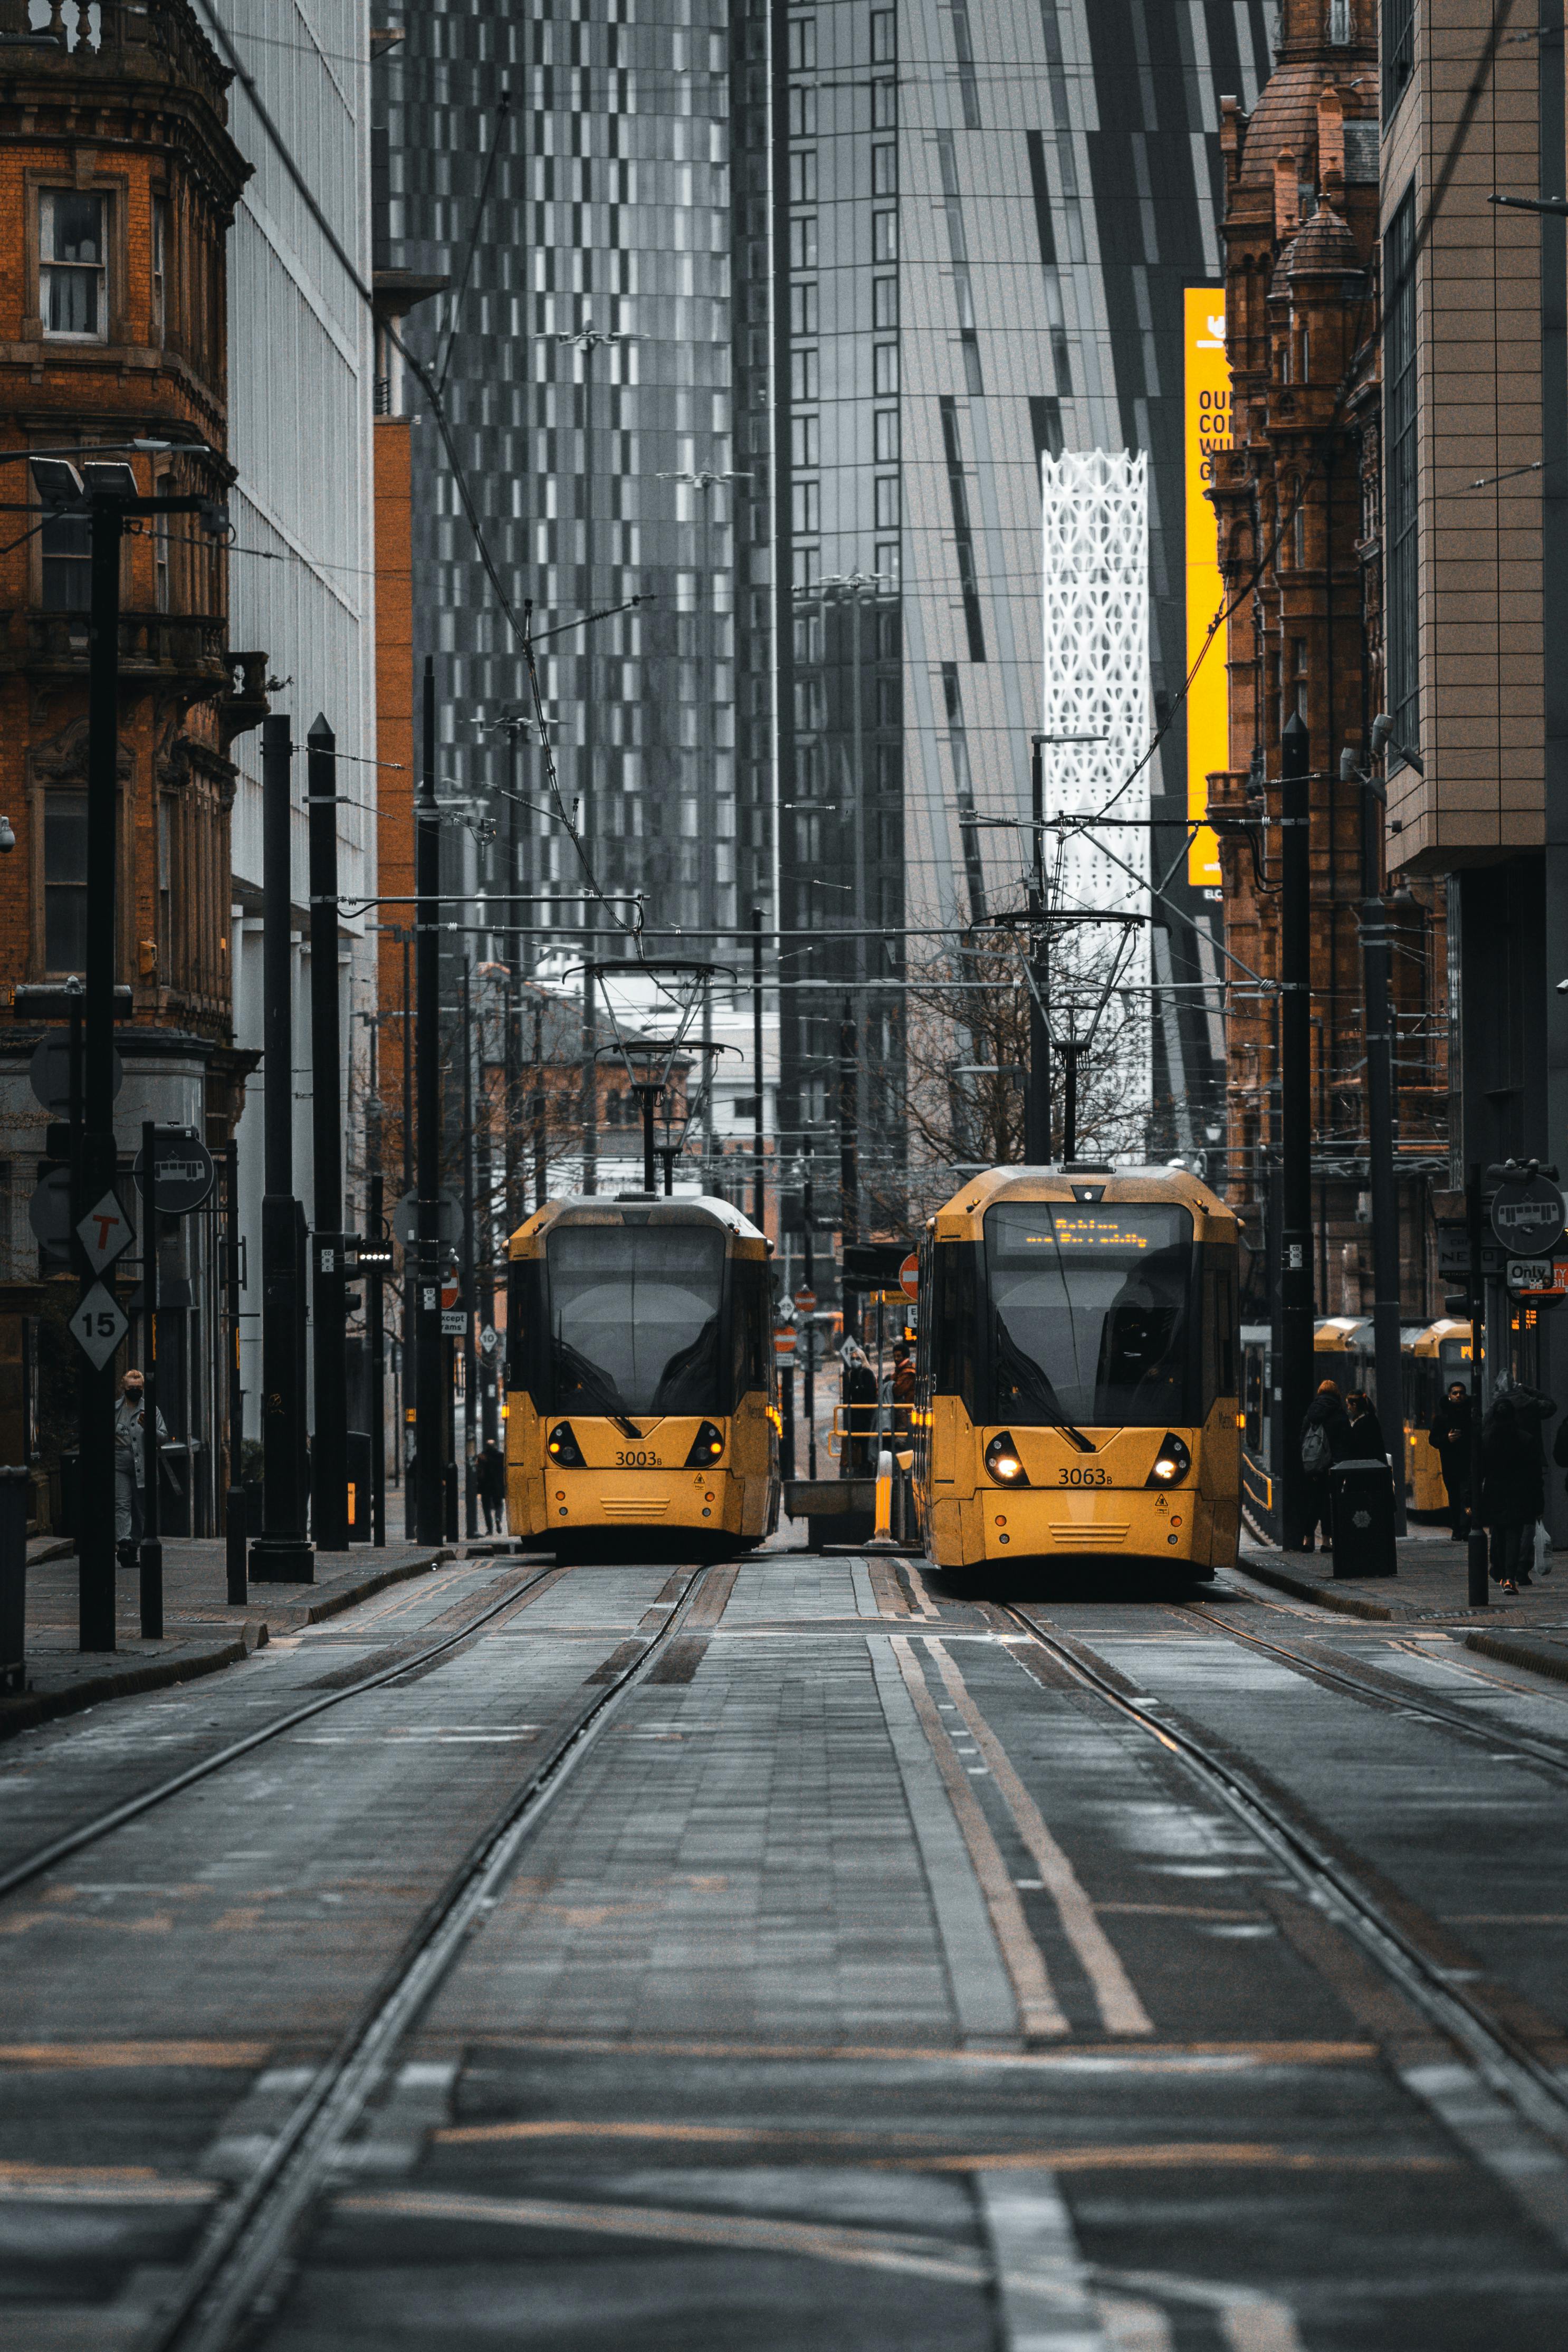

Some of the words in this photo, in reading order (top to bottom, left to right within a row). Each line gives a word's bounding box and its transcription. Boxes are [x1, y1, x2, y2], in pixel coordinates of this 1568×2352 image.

[92, 1215, 120, 1250] T
[1442, 1251, 1494, 1263] NEO
[1512, 1265, 1546, 1279] Only
[82, 1313, 115, 1337] 15
[615, 1451, 662, 1466] 3003B
[1058, 1468, 1113, 1485] 3063B
